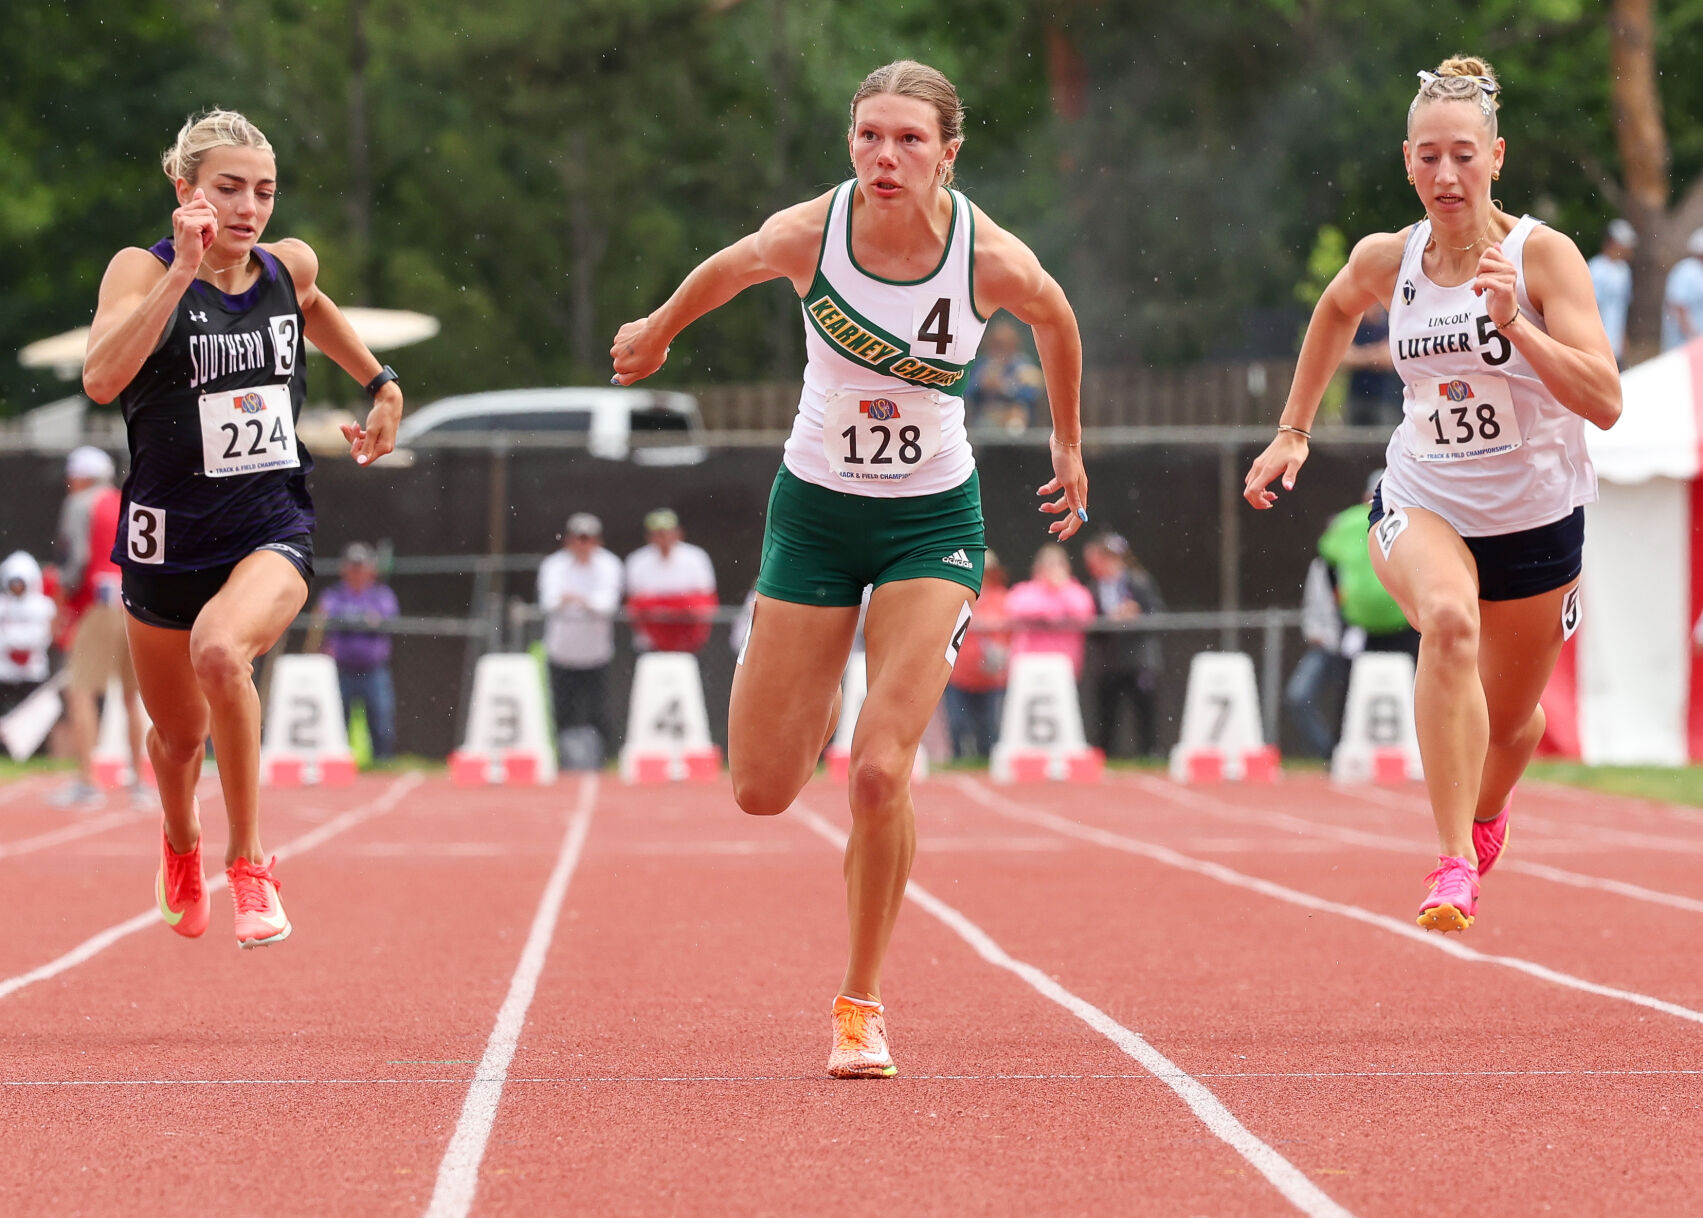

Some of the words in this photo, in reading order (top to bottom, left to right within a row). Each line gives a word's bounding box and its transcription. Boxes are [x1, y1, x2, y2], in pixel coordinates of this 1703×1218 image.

[810, 298, 900, 363] KEARNEY
[917, 297, 954, 355] 4
[1428, 312, 1472, 328] LINCOLN
[1476, 314, 1512, 366] 5
[189, 330, 265, 388] SOUTHERN
[279, 319, 295, 370] 3
[1398, 332, 1472, 360] LUTHER
[220, 416, 288, 459] 224
[841, 425, 922, 464] 128
[1428, 403, 1501, 445] 138
[216, 465, 233, 474] TRACK
[241, 463, 256, 471] FIELD
[1466, 444, 1512, 457] CHAMPIONSHIPS
[131, 509, 158, 559] 3
[942, 557, 973, 569] adidas
[1565, 584, 1580, 630] 5
[654, 697, 686, 738] 4
[1208, 695, 1233, 743] 7
